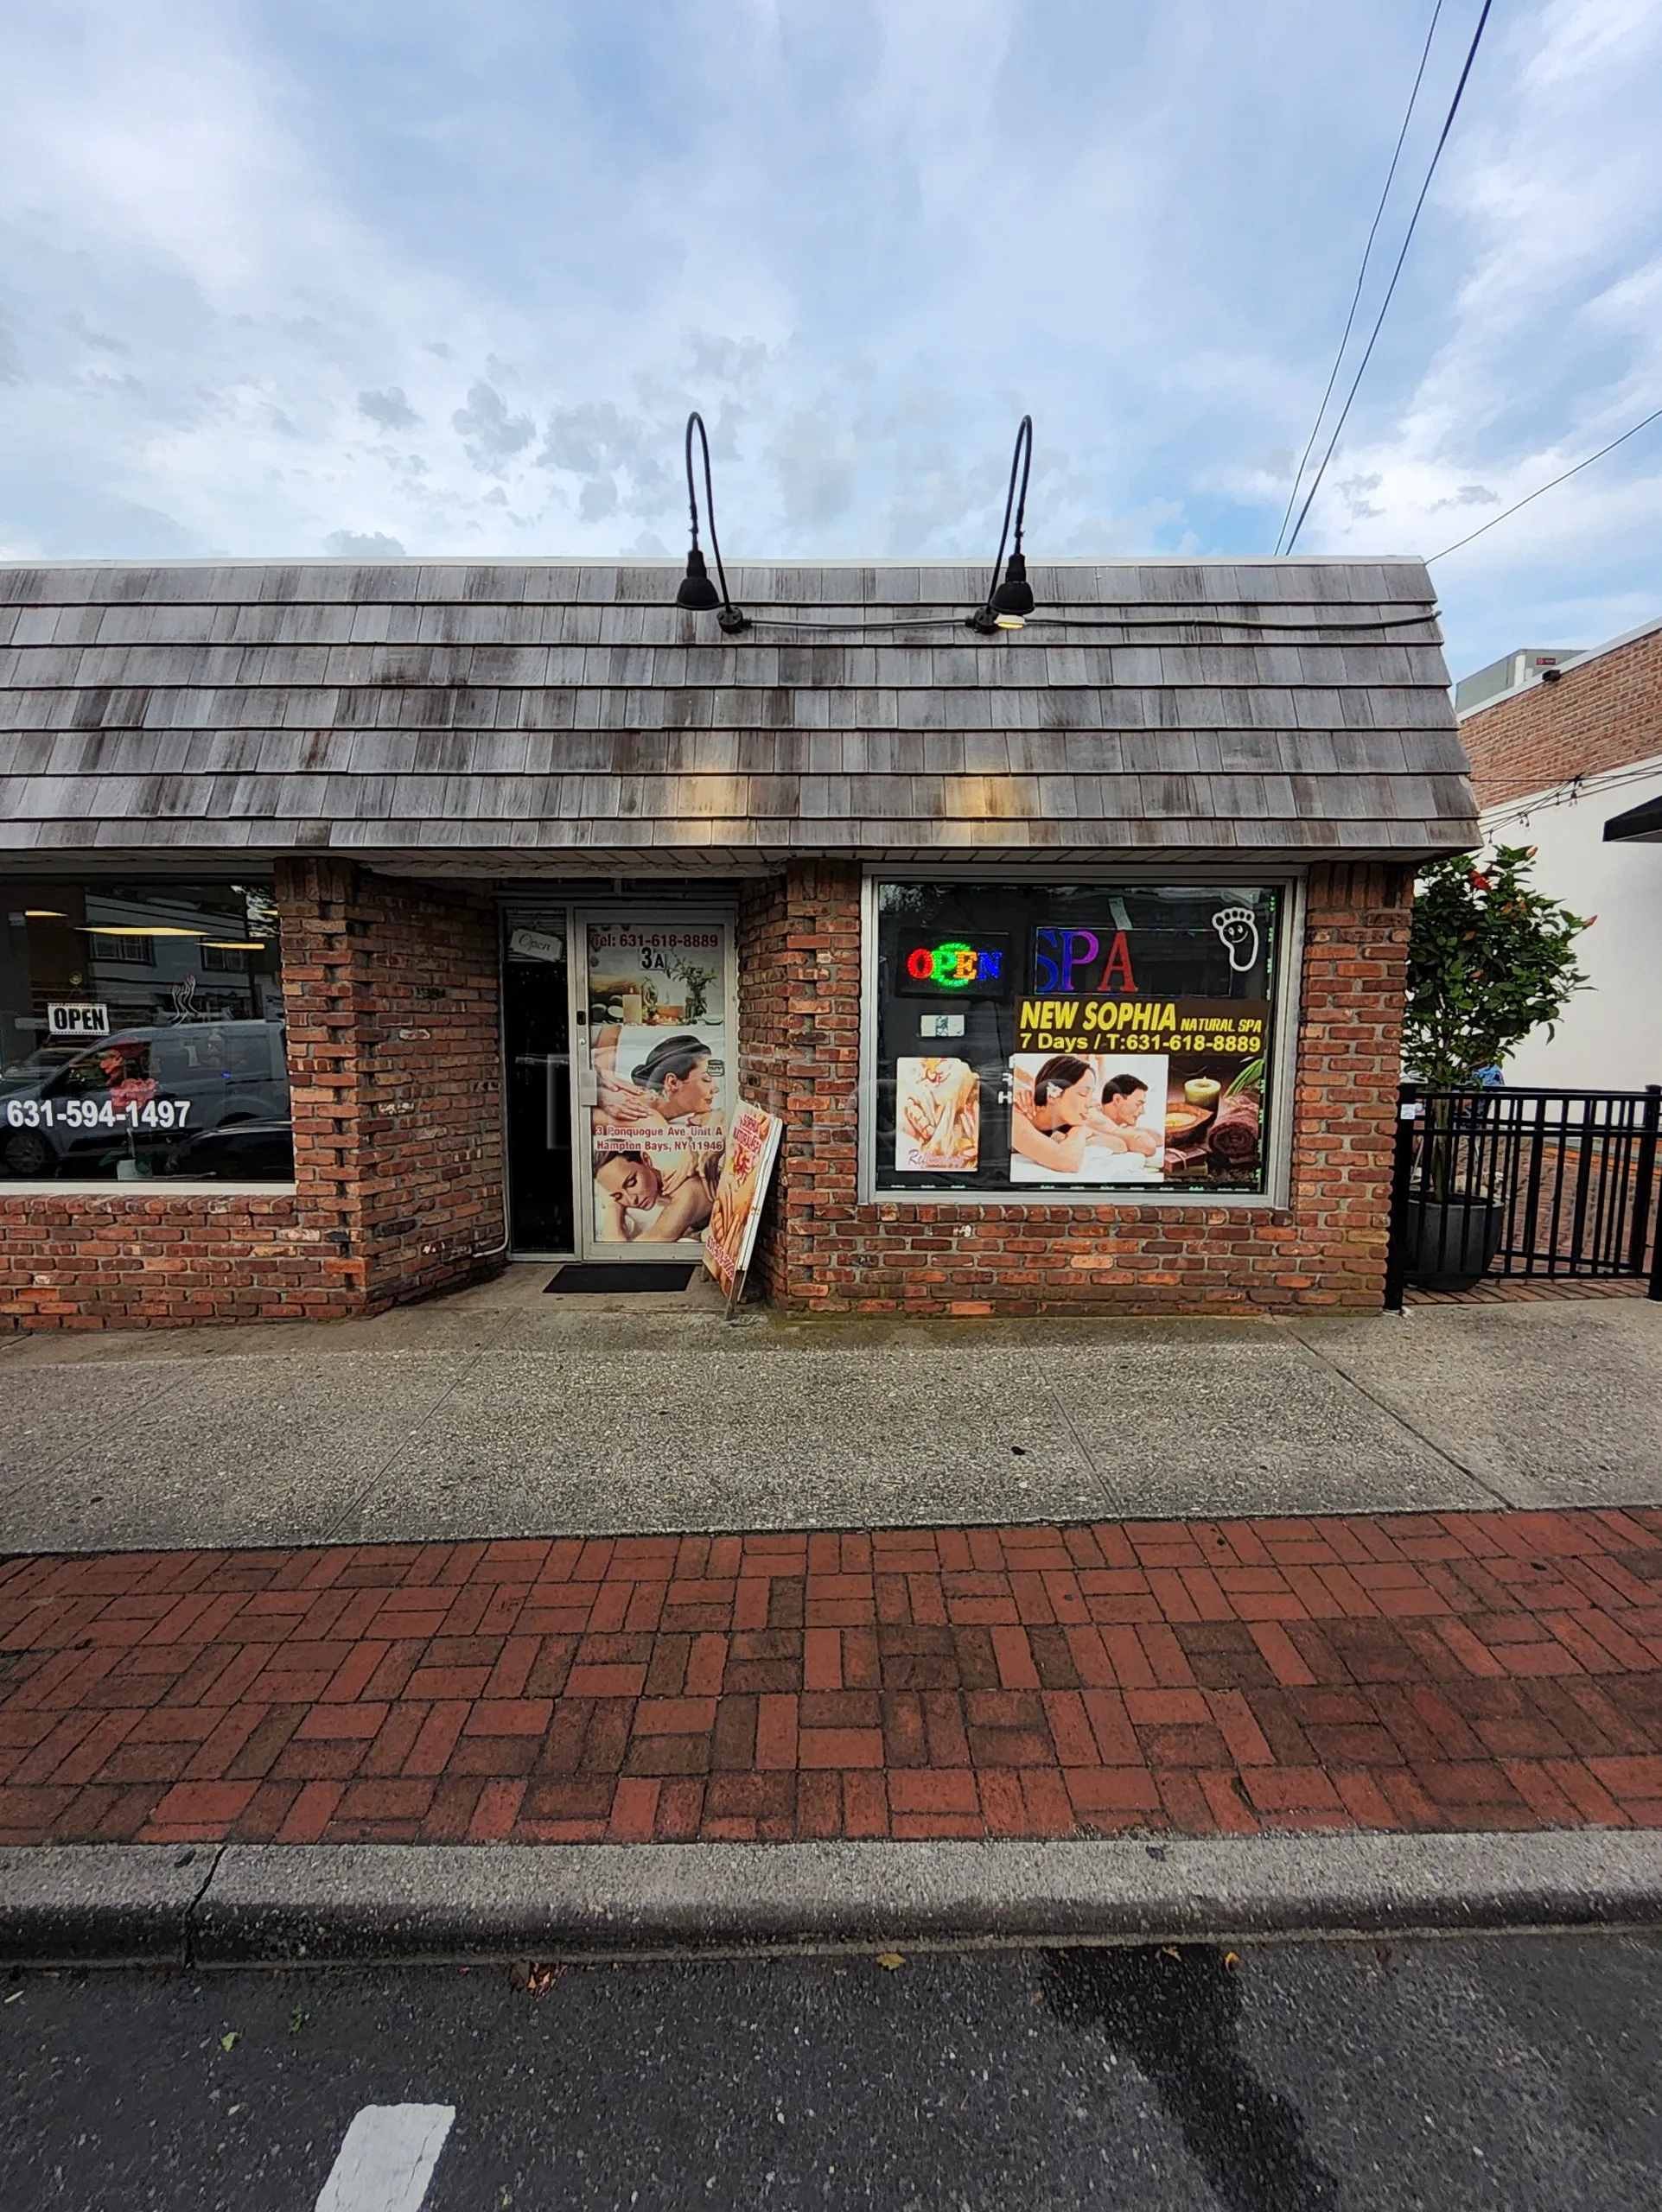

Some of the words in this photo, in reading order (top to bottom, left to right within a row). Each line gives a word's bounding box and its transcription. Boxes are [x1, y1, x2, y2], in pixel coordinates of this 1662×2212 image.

[519, 933, 551, 951] Open
[592, 933, 615, 947] Tel:
[620, 934, 718, 947] 631-618-8889
[907, 948, 1003, 980] OPEN
[1037, 930, 1138, 992] SPA
[54, 1007, 105, 1030] OPEN
[1020, 1001, 1079, 1029] NEW
[1082, 1002, 1175, 1031] SOPHIA
[1181, 1018, 1235, 1032] NATURAL
[1238, 1019, 1262, 1033] SPA
[1021, 1033, 1032, 1048] 7
[1038, 1033, 1088, 1052] Days
[7, 1100, 190, 1128] 631-594-1497
[608, 1127, 663, 1137] Ponquogue
[668, 1127, 685, 1135] Ave
[691, 1127, 710, 1135] Unit
[716, 1127, 723, 1135] A
[597, 1141, 640, 1151] Hampton
[645, 1141, 672, 1151] Bays,
[675, 1141, 687, 1150] NY
[692, 1141, 723, 1150] 11946
